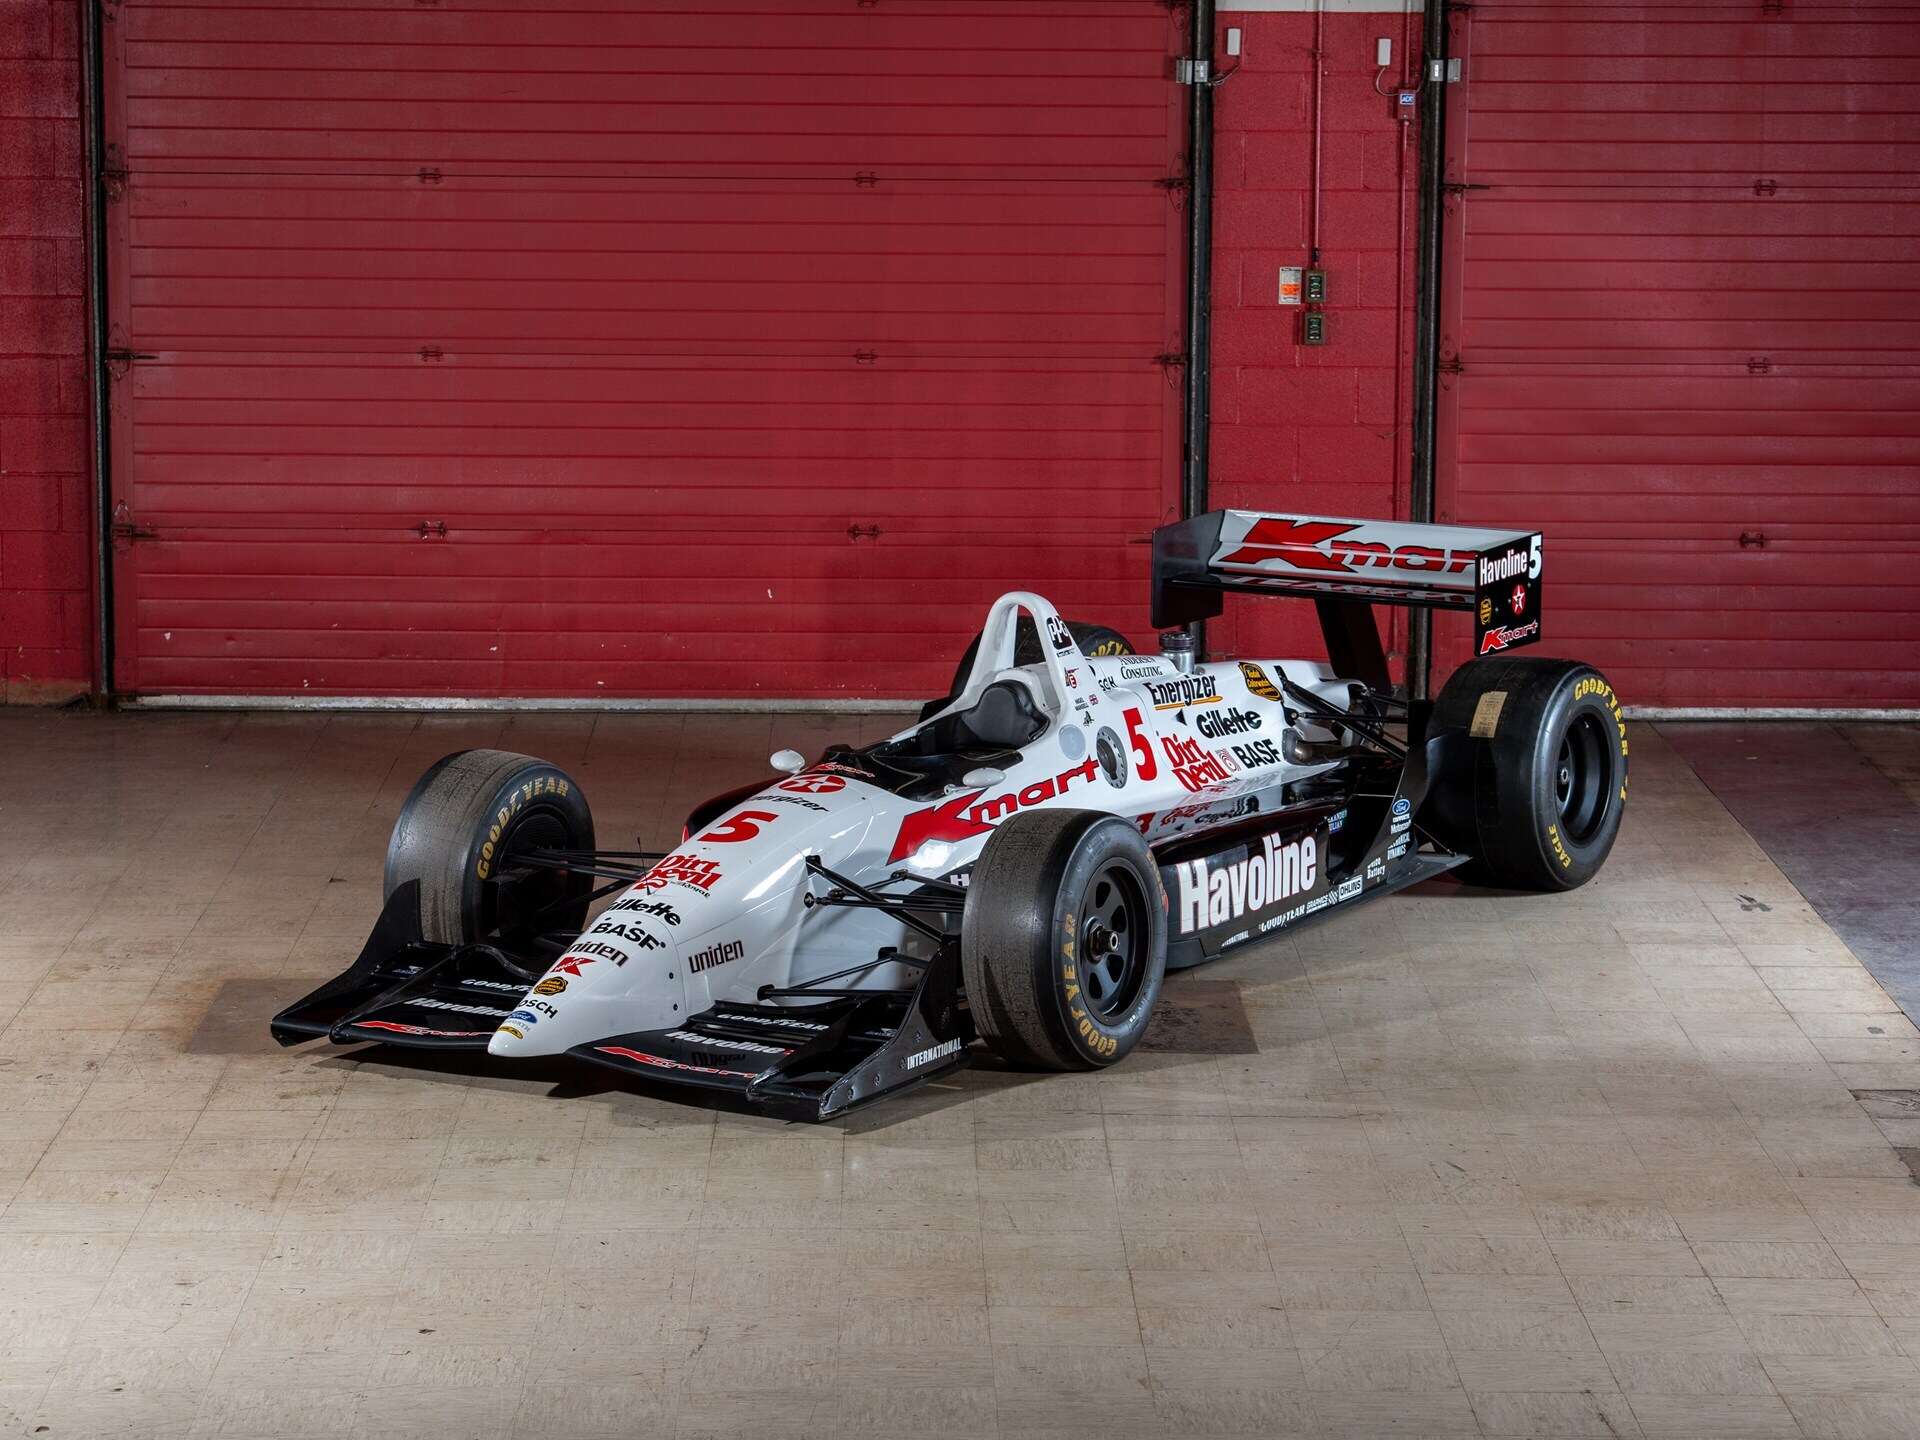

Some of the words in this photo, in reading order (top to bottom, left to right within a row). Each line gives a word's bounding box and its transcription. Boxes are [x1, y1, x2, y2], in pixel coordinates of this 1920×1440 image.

[1219, 518, 1476, 573] Kmar
[1528, 535, 1542, 579] 5
[1480, 549, 1528, 586] Havoline
[1480, 619, 1538, 654] Kmart
[1143, 673, 1217, 706] Energizer
[1196, 707, 1262, 739] Gillette
[1574, 678, 1628, 756] GOODYEAR
[1122, 707, 1158, 782] 5
[1161, 733, 1208, 768] Dirt
[1231, 739, 1282, 768] BASF
[1171, 750, 1231, 793] Devil
[697, 810, 780, 843] 5
[886, 755, 1100, 866] Kmart
[477, 776, 570, 880] GOODYEAR
[1548, 823, 1571, 868] EAGLE
[632, 868, 722, 891] Devil
[655, 854, 720, 873] Dirt
[1176, 831, 1317, 934] Havoline
[608, 899, 681, 927] illette
[591, 922, 660, 951] BASF
[567, 941, 629, 968] niden
[688, 940, 745, 974] uniden
[1061, 912, 1117, 1056] GOODYEAR
[518, 999, 558, 1019] OSCH
[717, 1014, 830, 1031] GOODYEAR
[664, 1031, 785, 1053] Havoline
[907, 1037, 962, 1070] INTERNATIONAL
